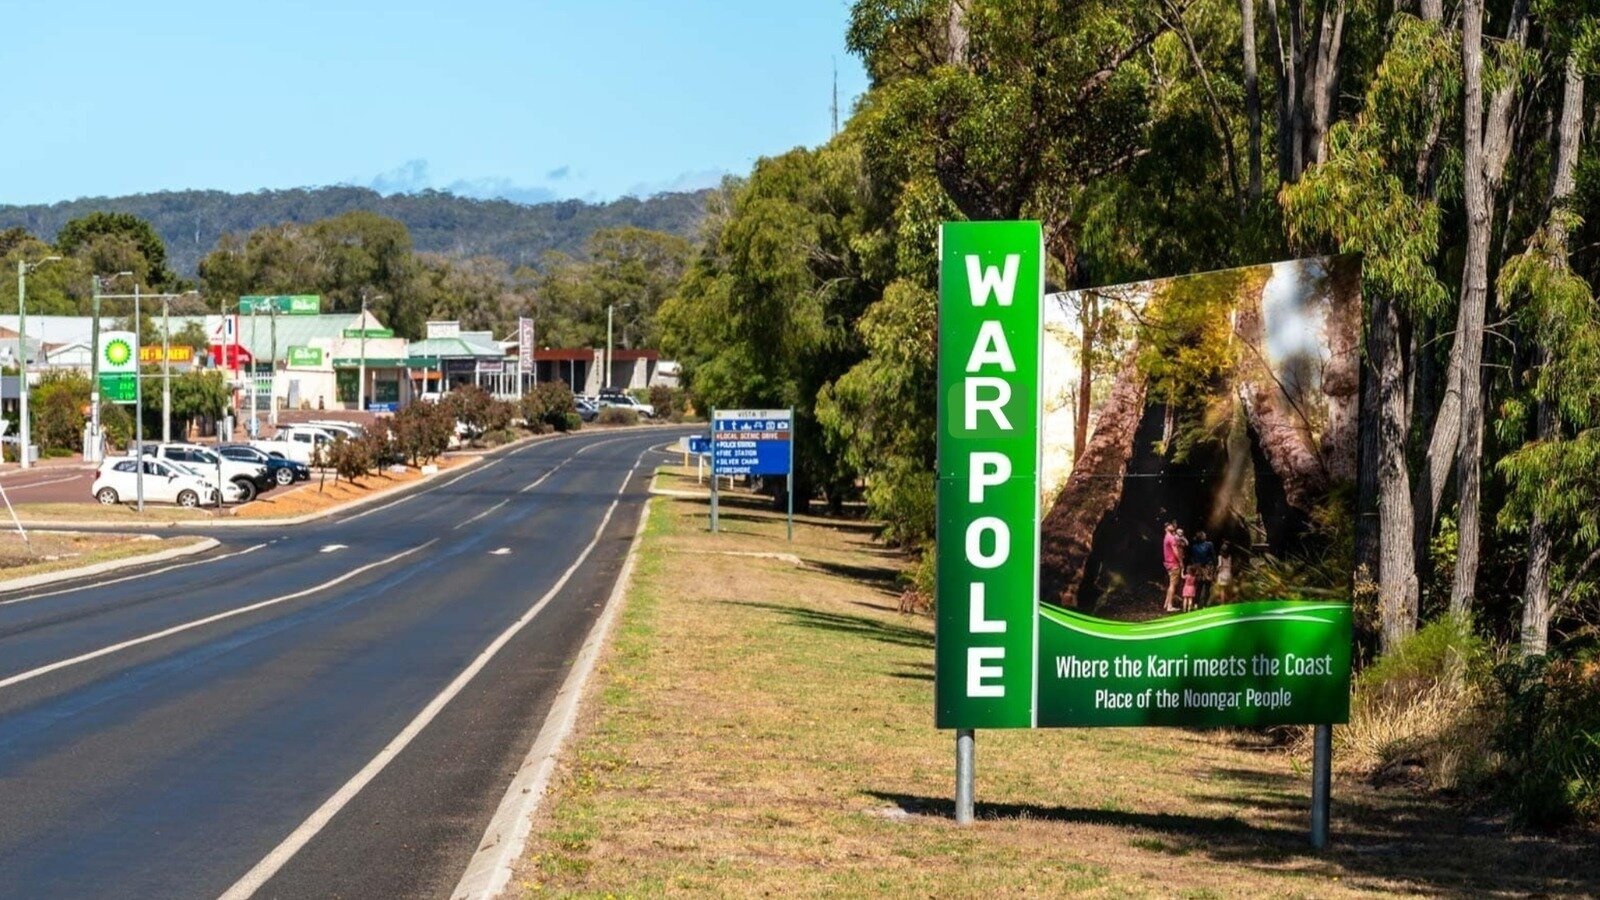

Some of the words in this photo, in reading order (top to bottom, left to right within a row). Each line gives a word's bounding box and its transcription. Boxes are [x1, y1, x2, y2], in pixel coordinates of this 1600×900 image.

[155, 348, 189, 360] BKERY
[1056, 655, 1109, 678] Where
[1113, 655, 1142, 678] the
[1147, 654, 1188, 678] Karri
[1193, 655, 1247, 677] meets
[1252, 654, 1280, 676] the
[1285, 653, 1333, 676] Coast
[1095, 689, 1132, 709] Place
[1136, 689, 1152, 708] of
[1156, 689, 1180, 708] the
[1184, 689, 1242, 711] Noongar
[1246, 687, 1292, 710] People
